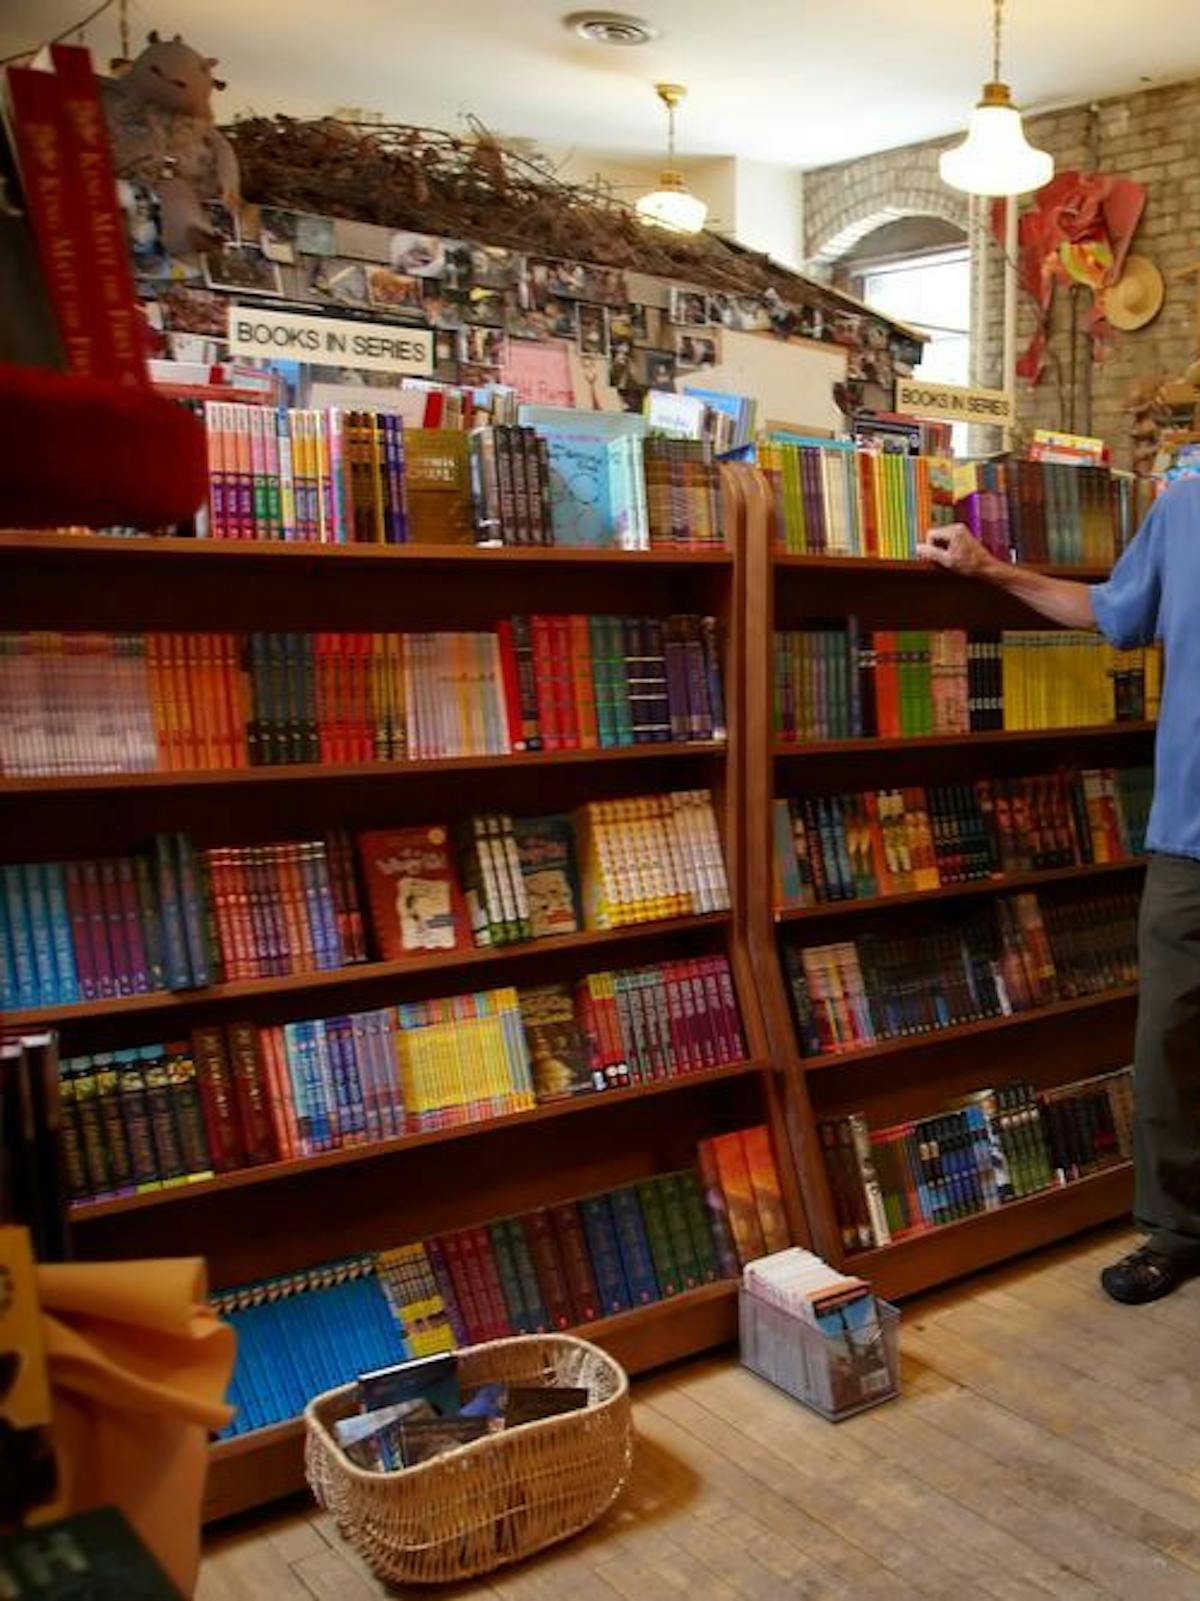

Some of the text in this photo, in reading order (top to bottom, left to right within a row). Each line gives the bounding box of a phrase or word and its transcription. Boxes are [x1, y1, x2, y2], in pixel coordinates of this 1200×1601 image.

[237, 320, 426, 363] BOOKS IN SERIES
[901, 387, 1011, 416] BOOKS IN SERIES
